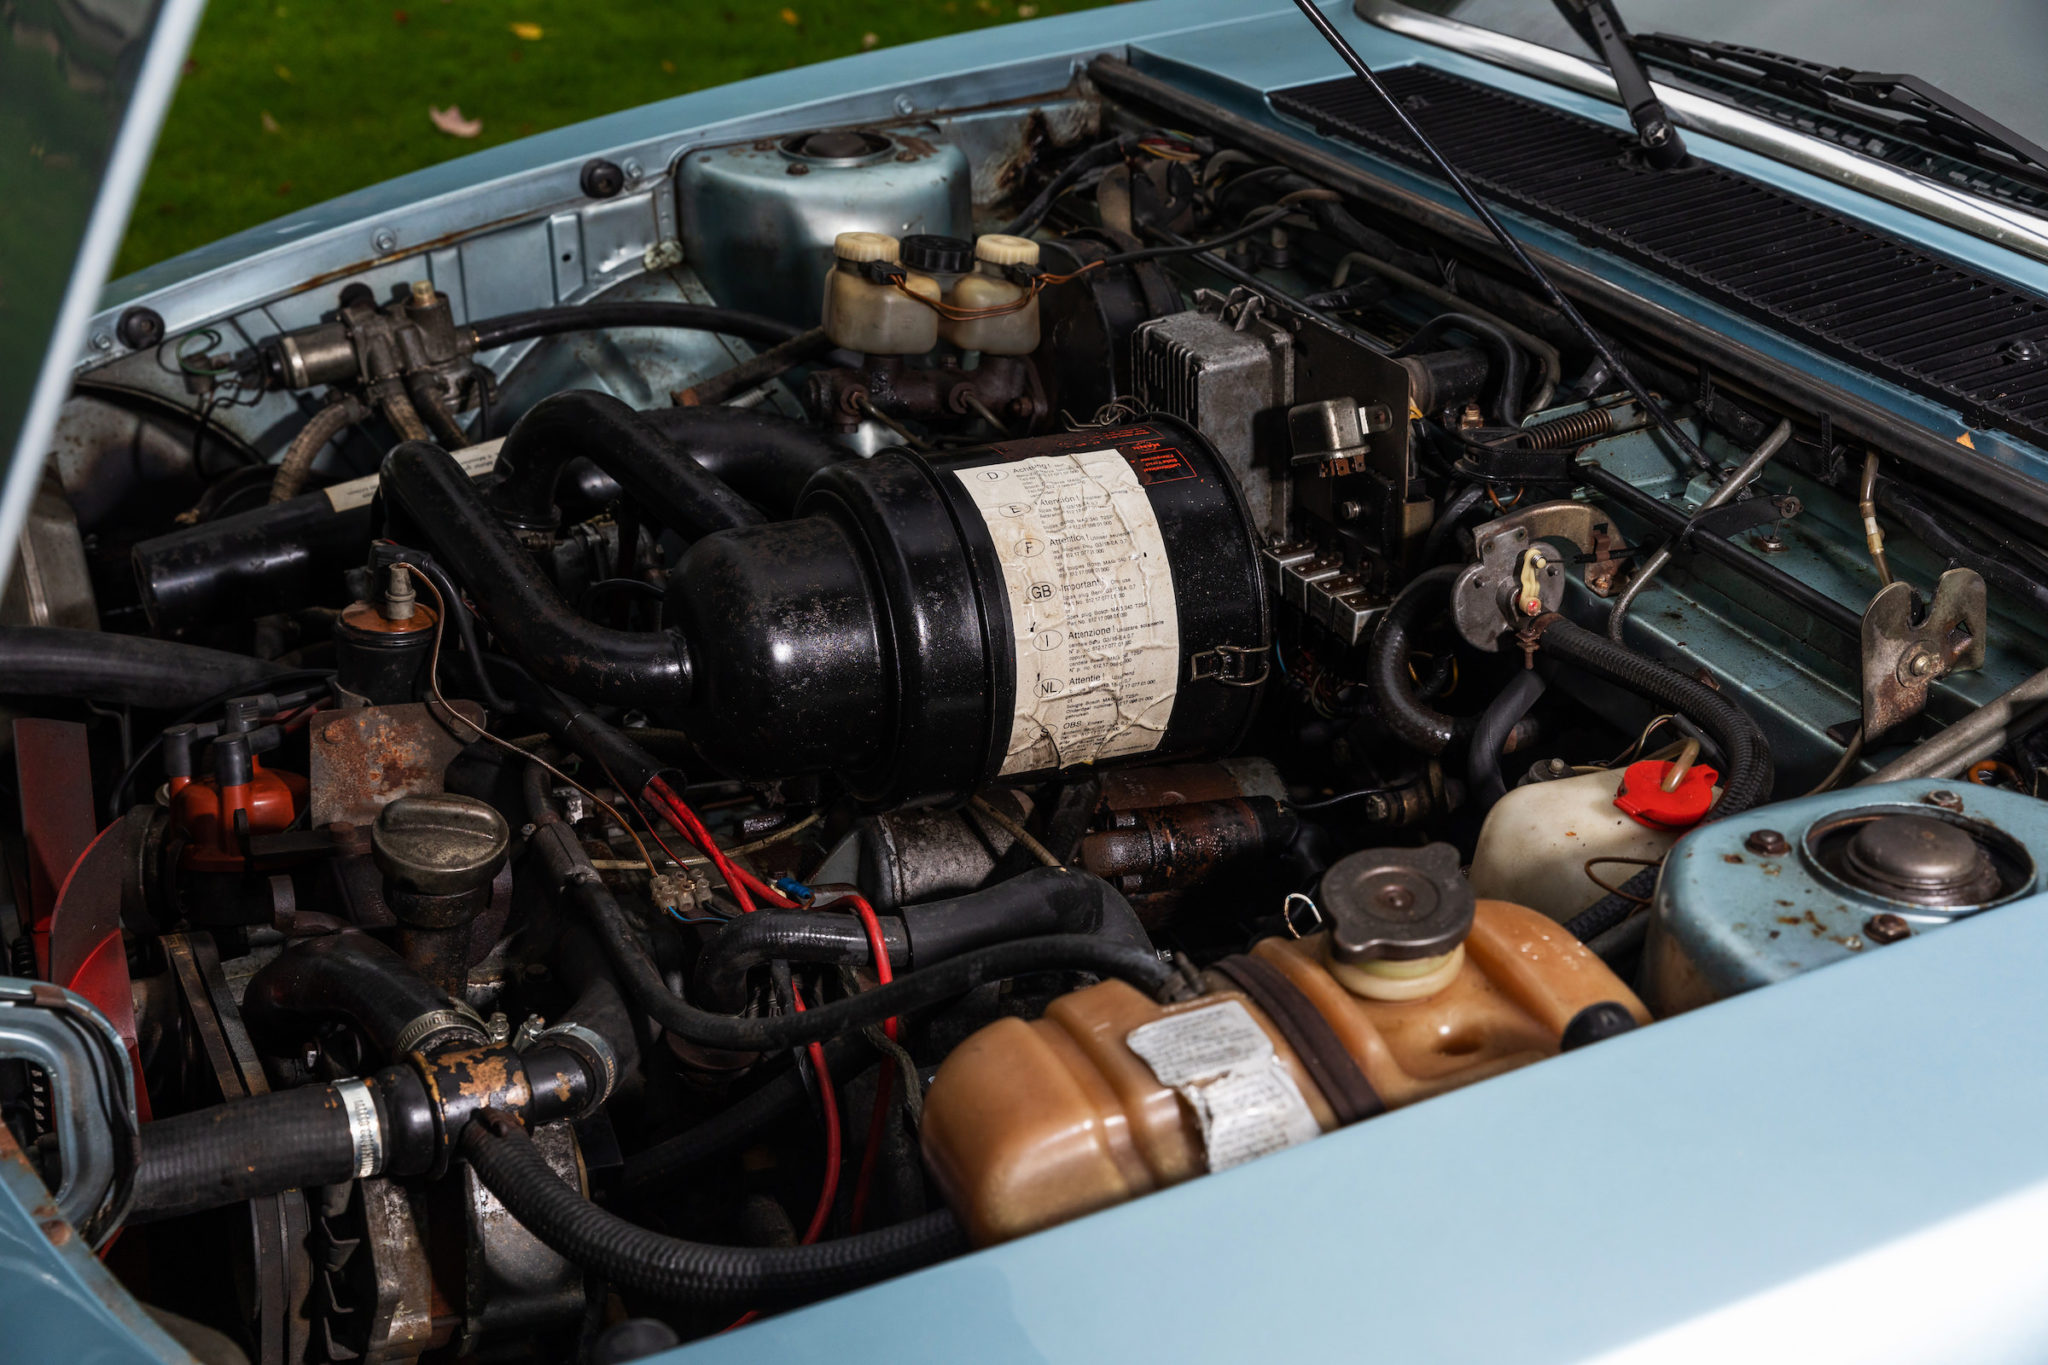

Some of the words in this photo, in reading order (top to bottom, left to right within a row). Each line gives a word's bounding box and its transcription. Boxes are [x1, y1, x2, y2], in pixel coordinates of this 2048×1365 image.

[987, 472, 998, 480] D
[1009, 506, 1020, 514] E
[1025, 542, 1032, 554] F
[1031, 584, 1052, 600] GB
[1041, 682, 1057, 694] NL
